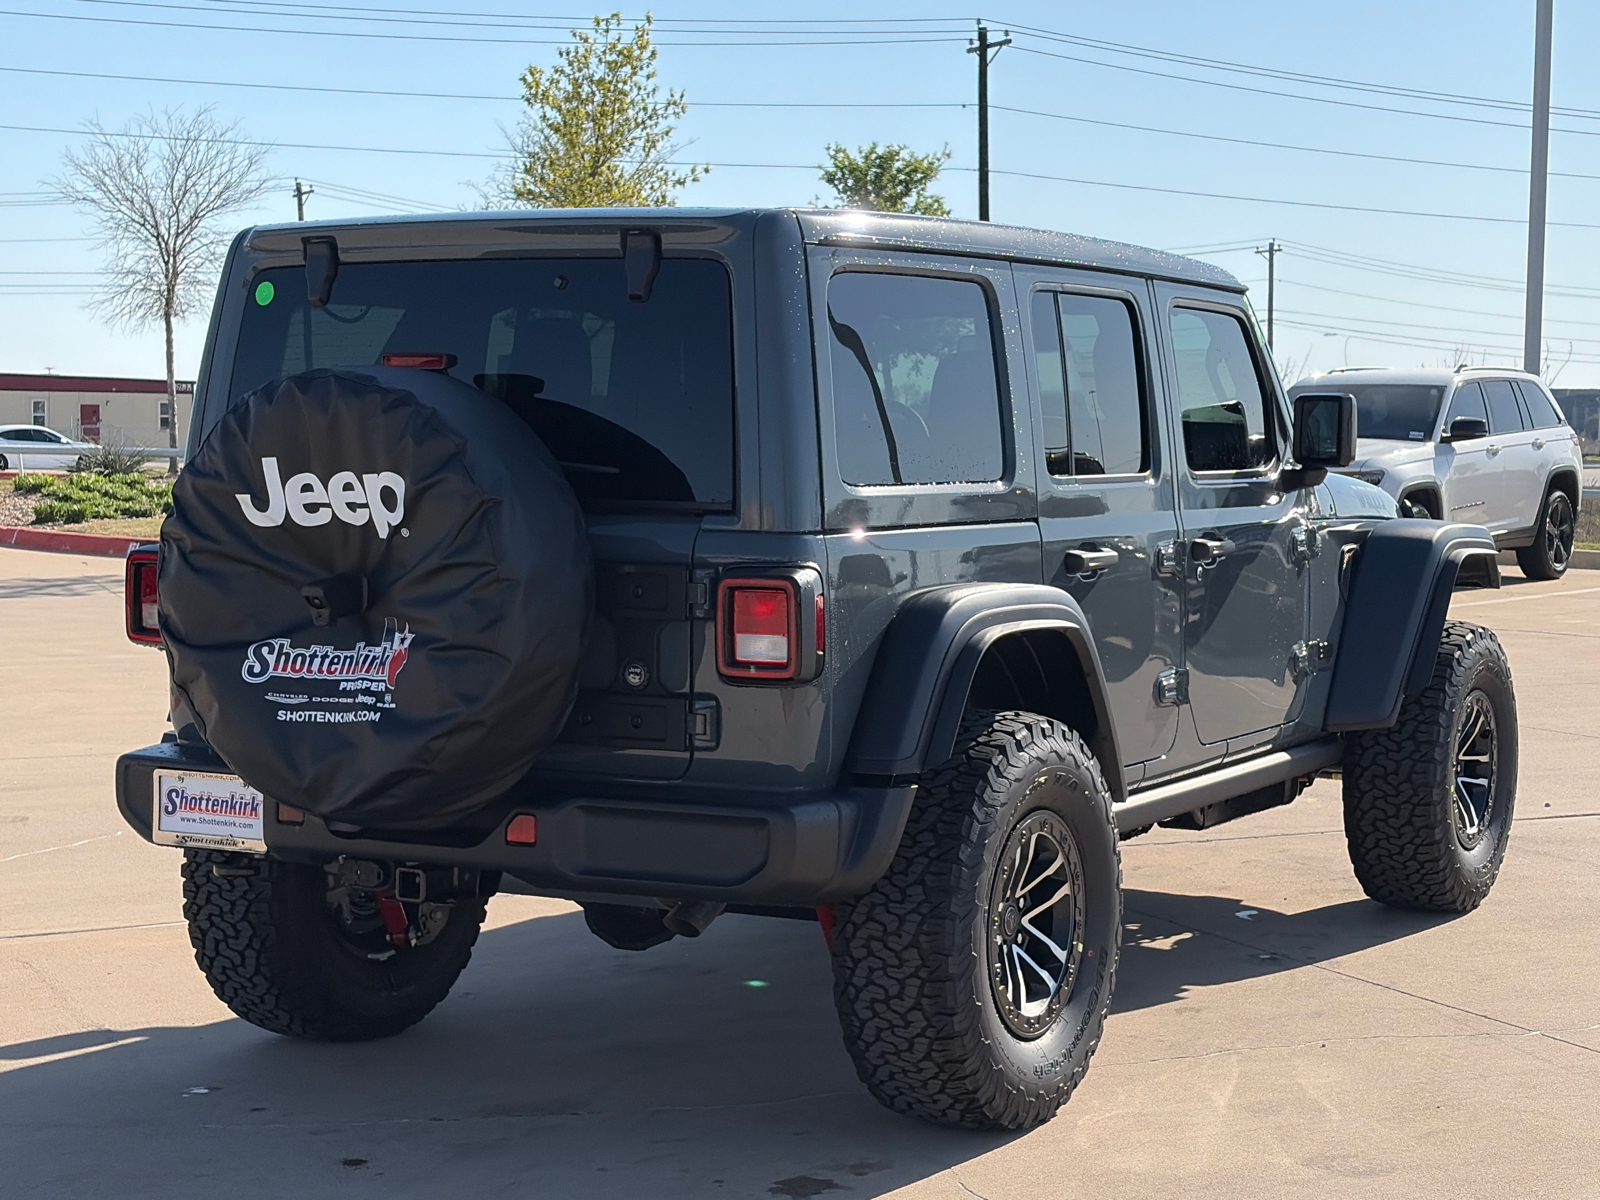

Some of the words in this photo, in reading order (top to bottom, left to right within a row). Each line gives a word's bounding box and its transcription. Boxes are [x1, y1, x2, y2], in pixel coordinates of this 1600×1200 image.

[235, 456, 406, 539] Jeep
[242, 638, 394, 684] Shottenkirk
[339, 680, 386, 692] PRSPER
[355, 693, 376, 706] Jeep
[276, 710, 381, 723] SHOTTENKIRK.COM
[164, 786, 261, 819] Shottenkirk
[179, 816, 254, 830] www.Shottenkirk.com
